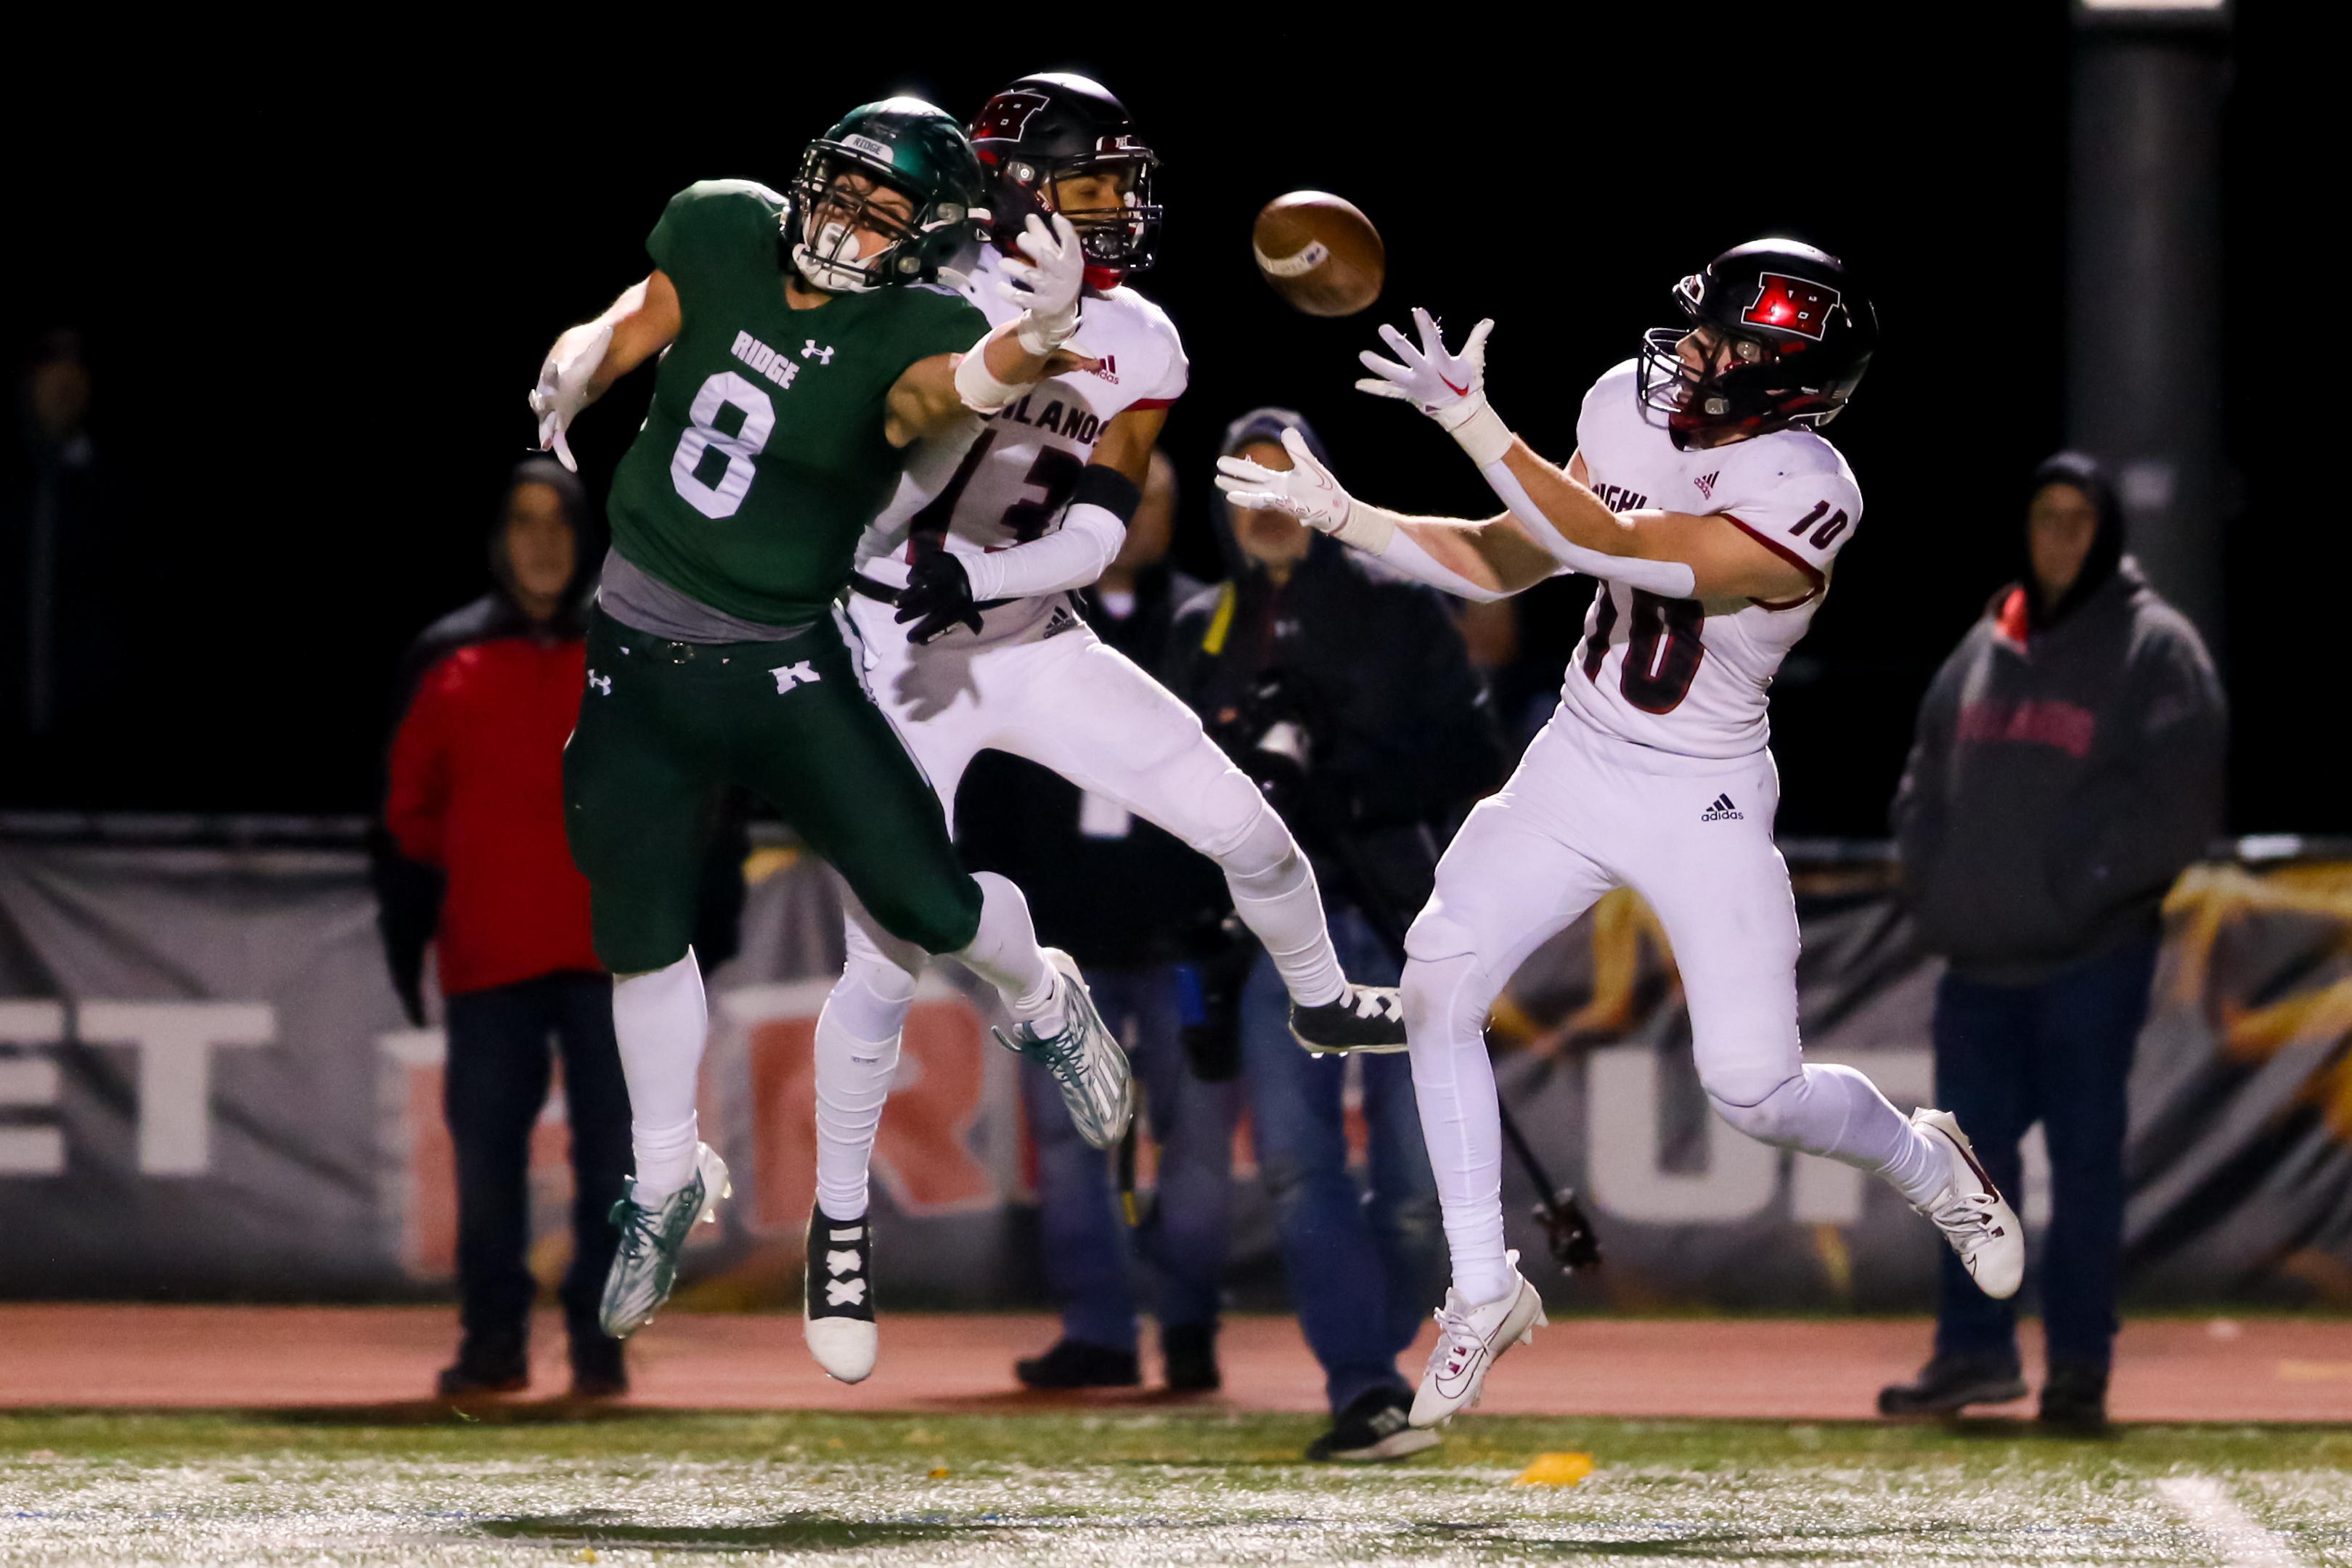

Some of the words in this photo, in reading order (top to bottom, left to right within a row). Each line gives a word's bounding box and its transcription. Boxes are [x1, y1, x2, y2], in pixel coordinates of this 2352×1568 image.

[853, 137, 883, 155] RIDGE
[730, 330, 799, 390] RIDGE
[670, 371, 776, 519] 8
[1788, 500, 1848, 550] 10
[1701, 810, 1744, 822] adidas
